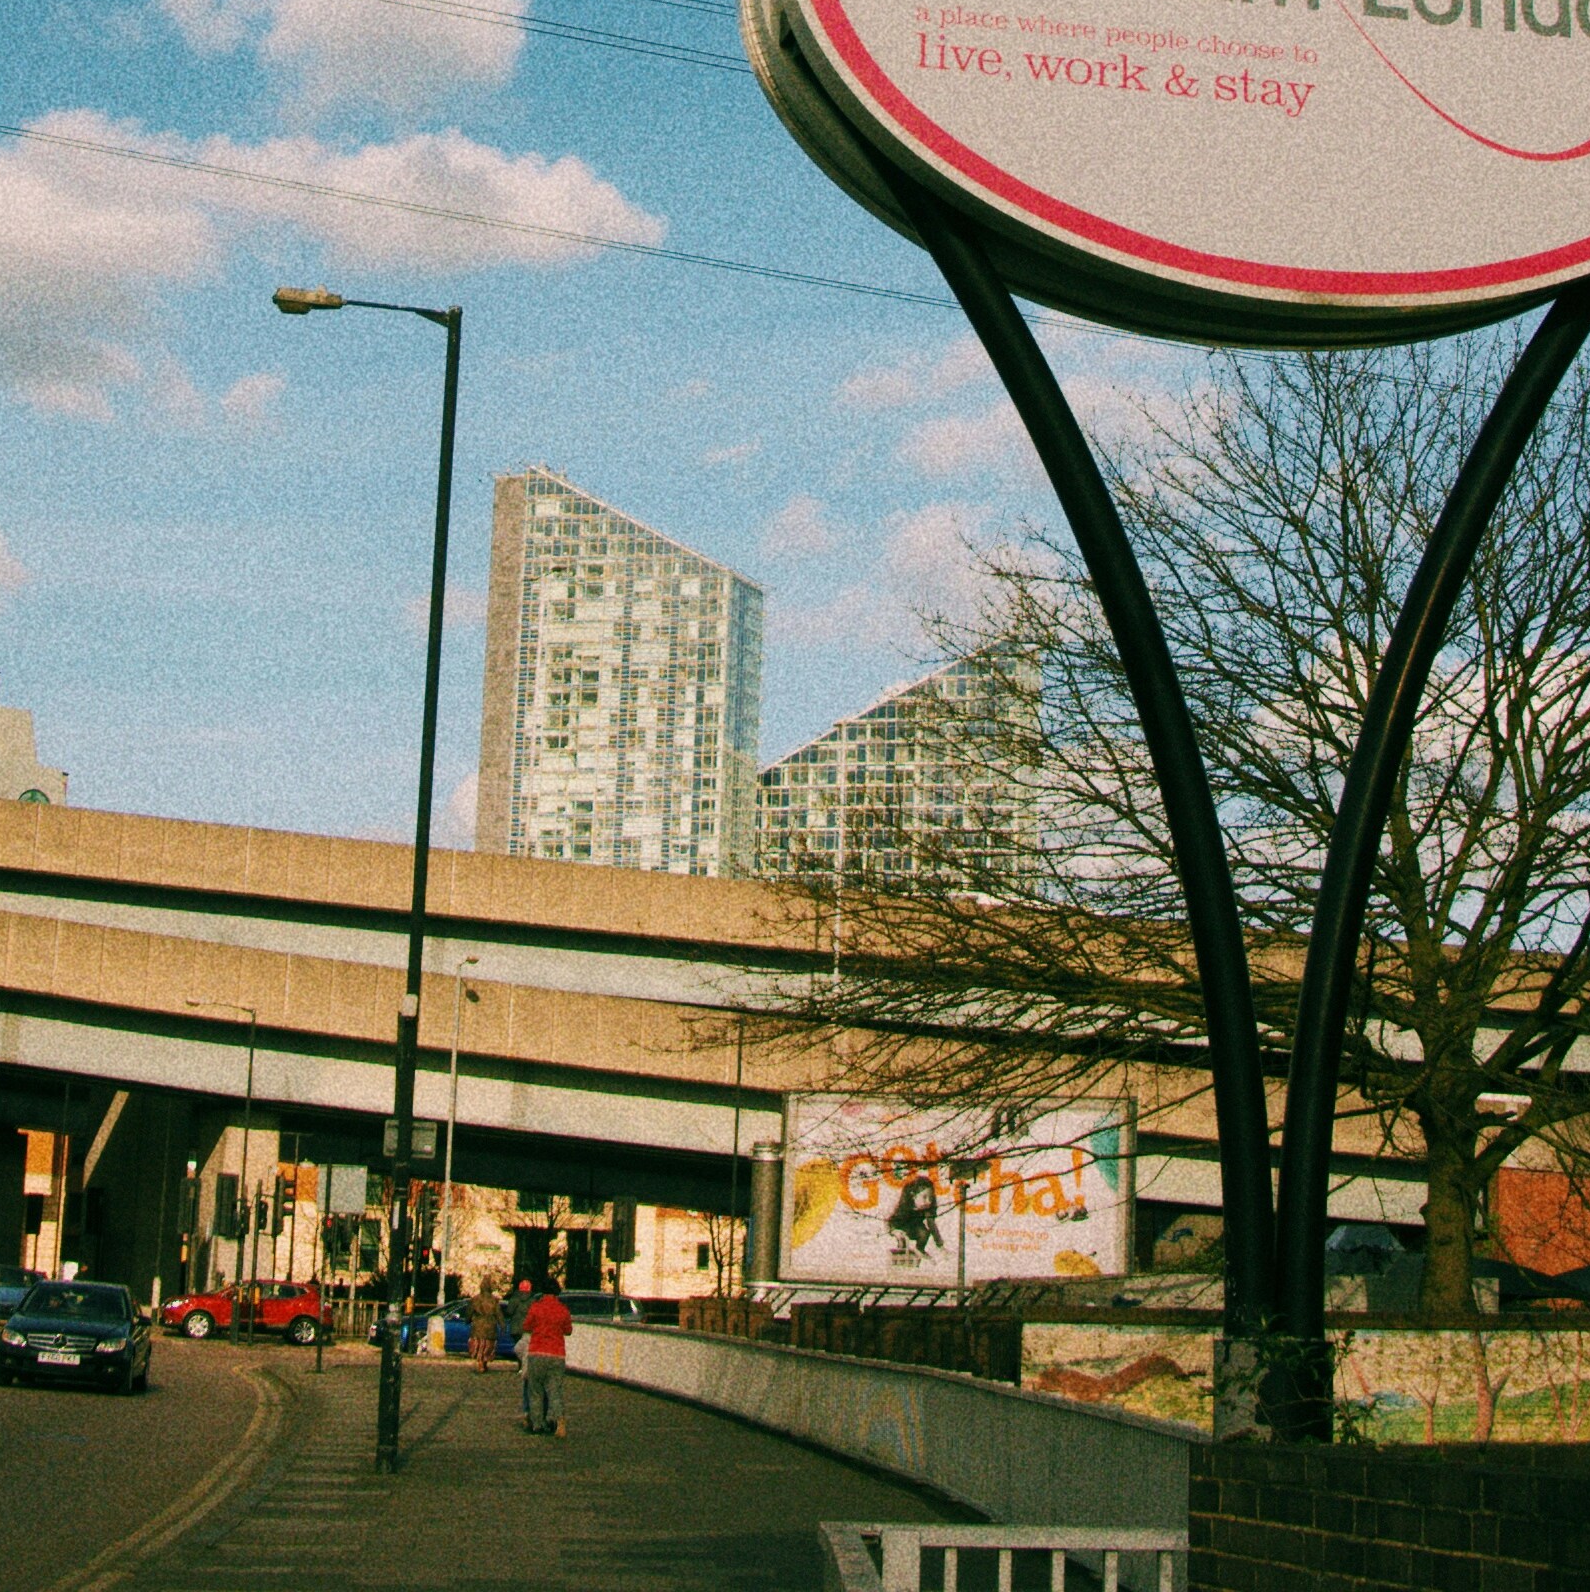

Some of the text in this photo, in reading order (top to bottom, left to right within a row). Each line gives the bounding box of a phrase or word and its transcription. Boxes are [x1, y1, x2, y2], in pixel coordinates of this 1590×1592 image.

[915, 6, 1318, 65] a place where people choose to
[915, 32, 1315, 118] live, work & stay
[838, 1139, 1087, 1218] Gotcha!
